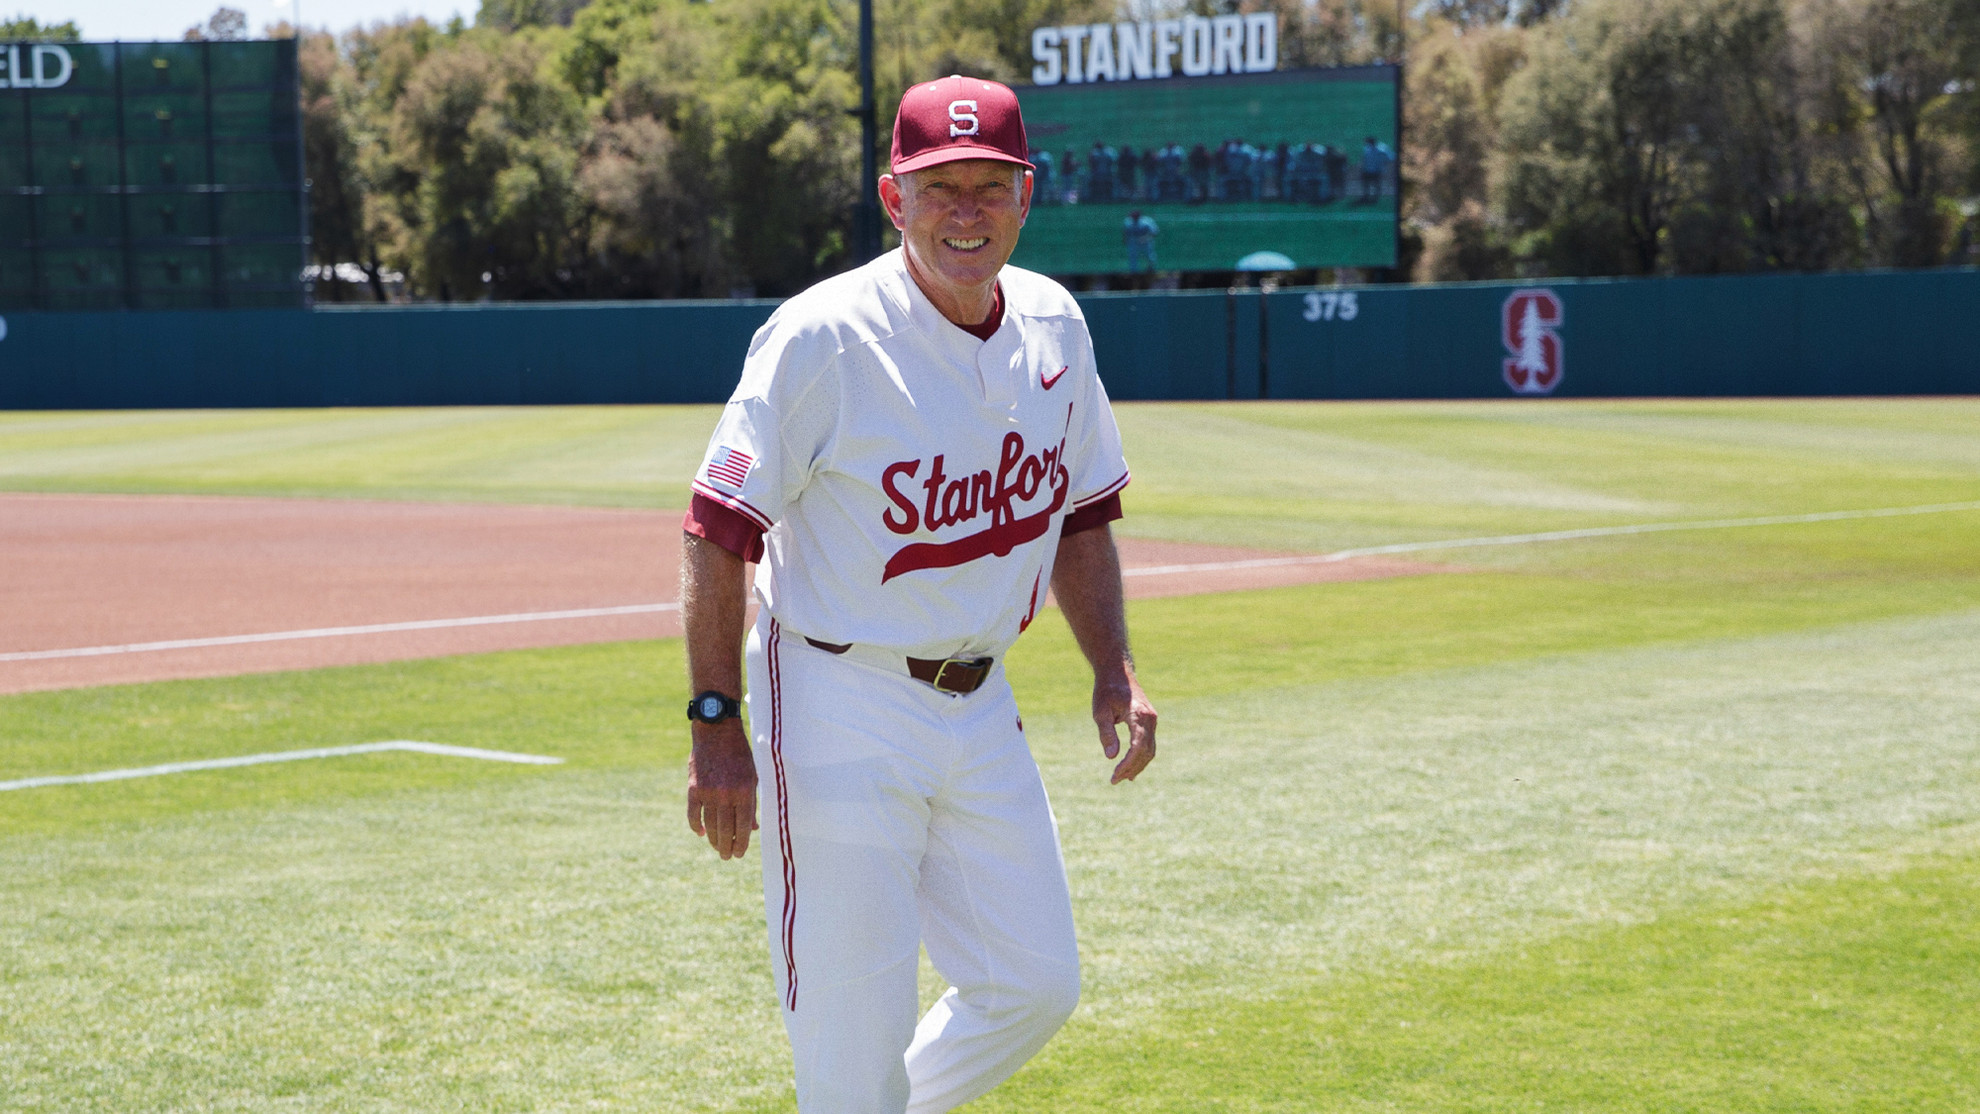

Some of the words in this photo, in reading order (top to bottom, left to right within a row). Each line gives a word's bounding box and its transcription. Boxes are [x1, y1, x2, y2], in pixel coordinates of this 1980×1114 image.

[1032, 12, 1278, 86] STANFORD
[948, 99, 979, 138] S
[1302, 291, 1359, 322] 375
